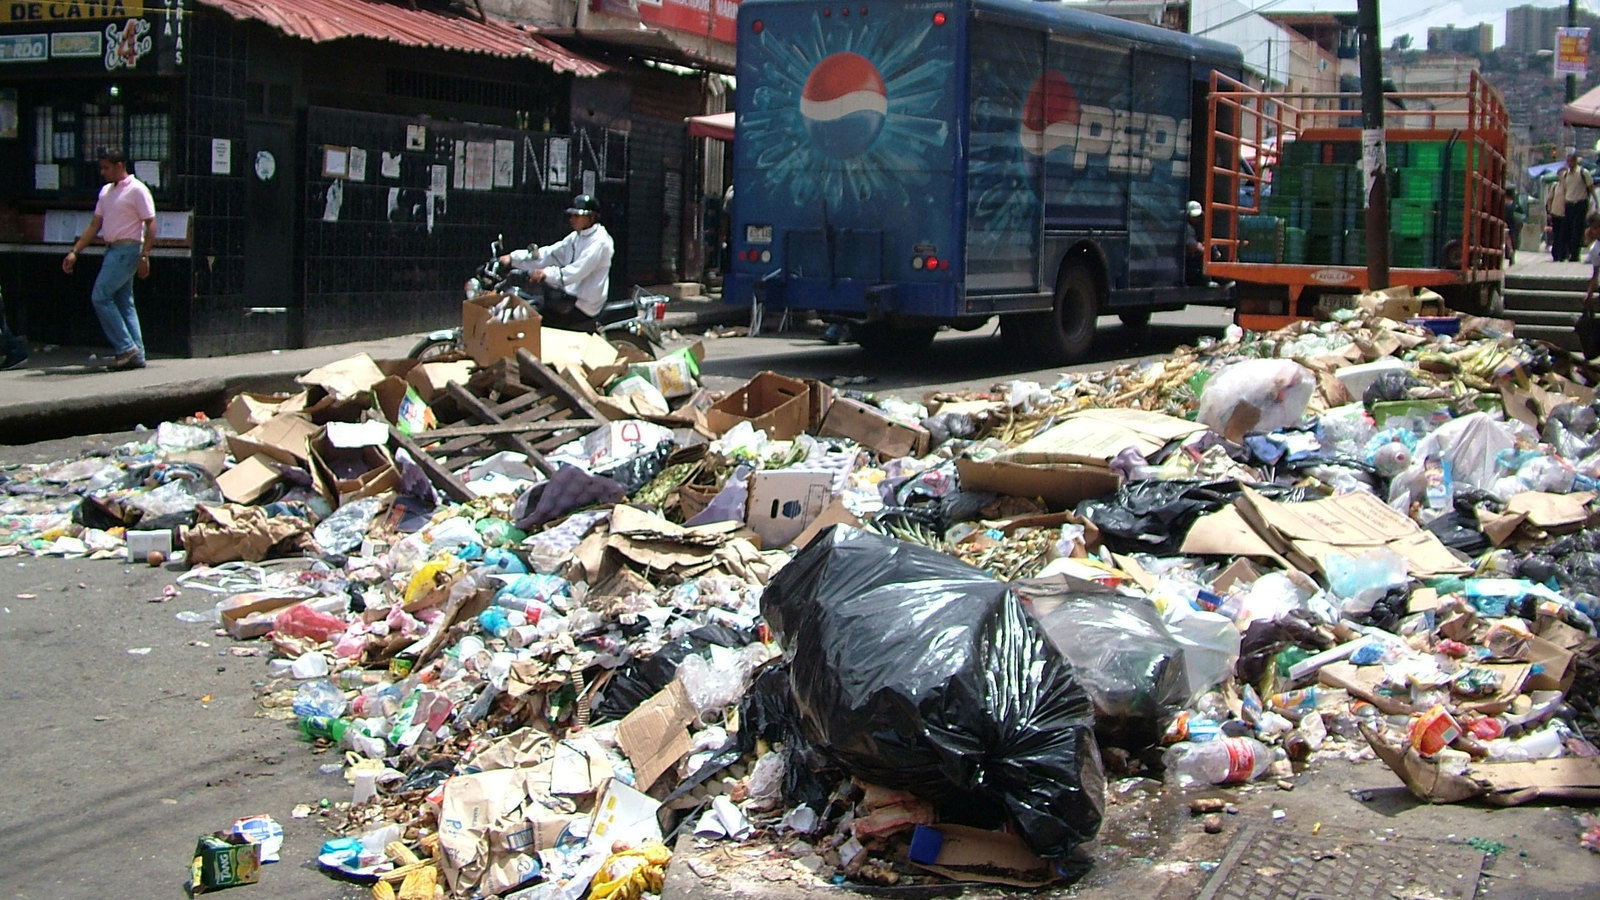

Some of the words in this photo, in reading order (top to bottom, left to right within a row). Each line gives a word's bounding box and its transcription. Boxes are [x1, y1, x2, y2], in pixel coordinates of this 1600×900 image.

[10, 3, 43, 20] DE
[48, 0, 126, 18] CATIA
[1073, 104, 1192, 177] PEPS
[220, 853, 232, 882] TANG
